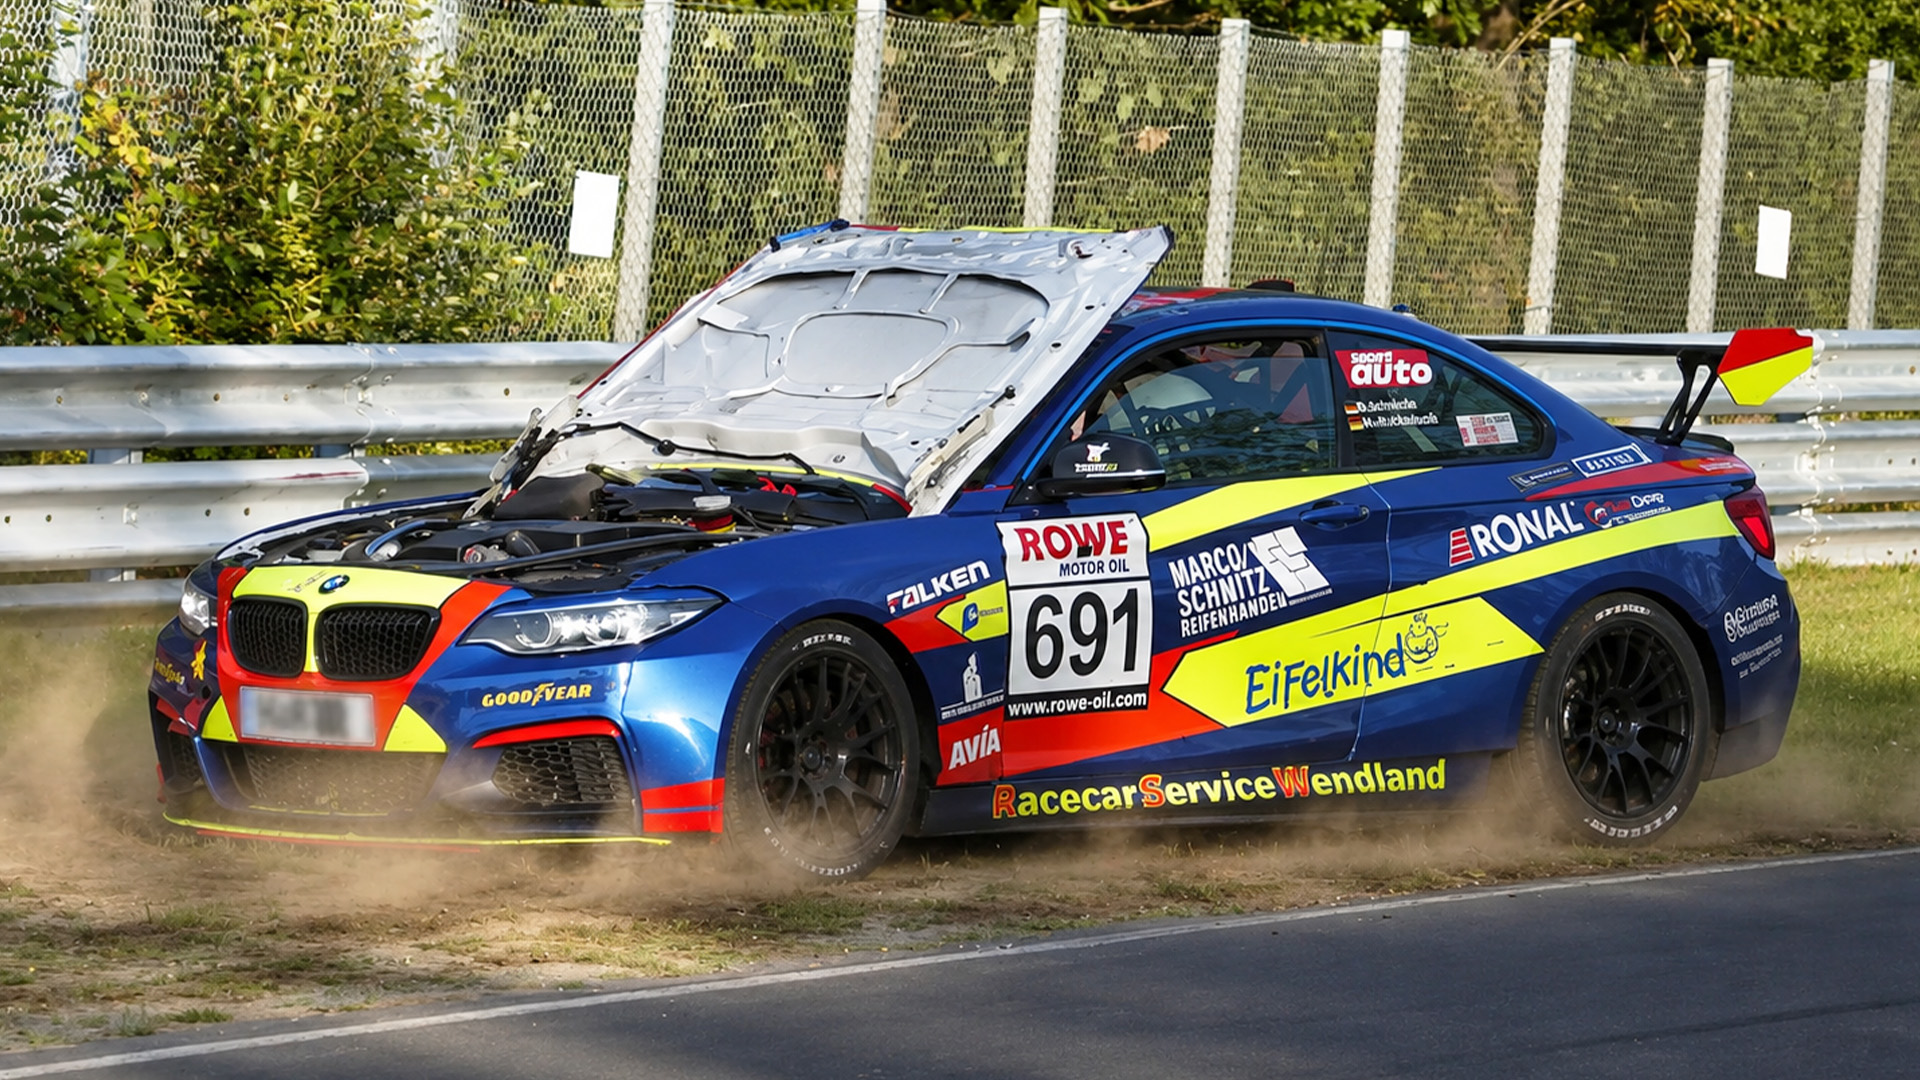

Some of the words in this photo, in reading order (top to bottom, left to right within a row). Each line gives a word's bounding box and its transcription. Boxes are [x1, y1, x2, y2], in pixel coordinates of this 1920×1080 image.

[1350, 359, 1433, 386] auto
[1014, 520, 1129, 562] ROWE
[1470, 502, 1585, 557] RONAL
[886, 560, 991, 614] FALKEN
[1058, 560, 1104, 577] MOTOR
[1108, 559, 1130, 573] OIL
[1177, 566, 1270, 617] SCHNITZ
[1025, 588, 1139, 679] 691
[481, 682, 592, 707] GOODYEAR
[1007, 690, 1147, 716] www.rowe-oil.com
